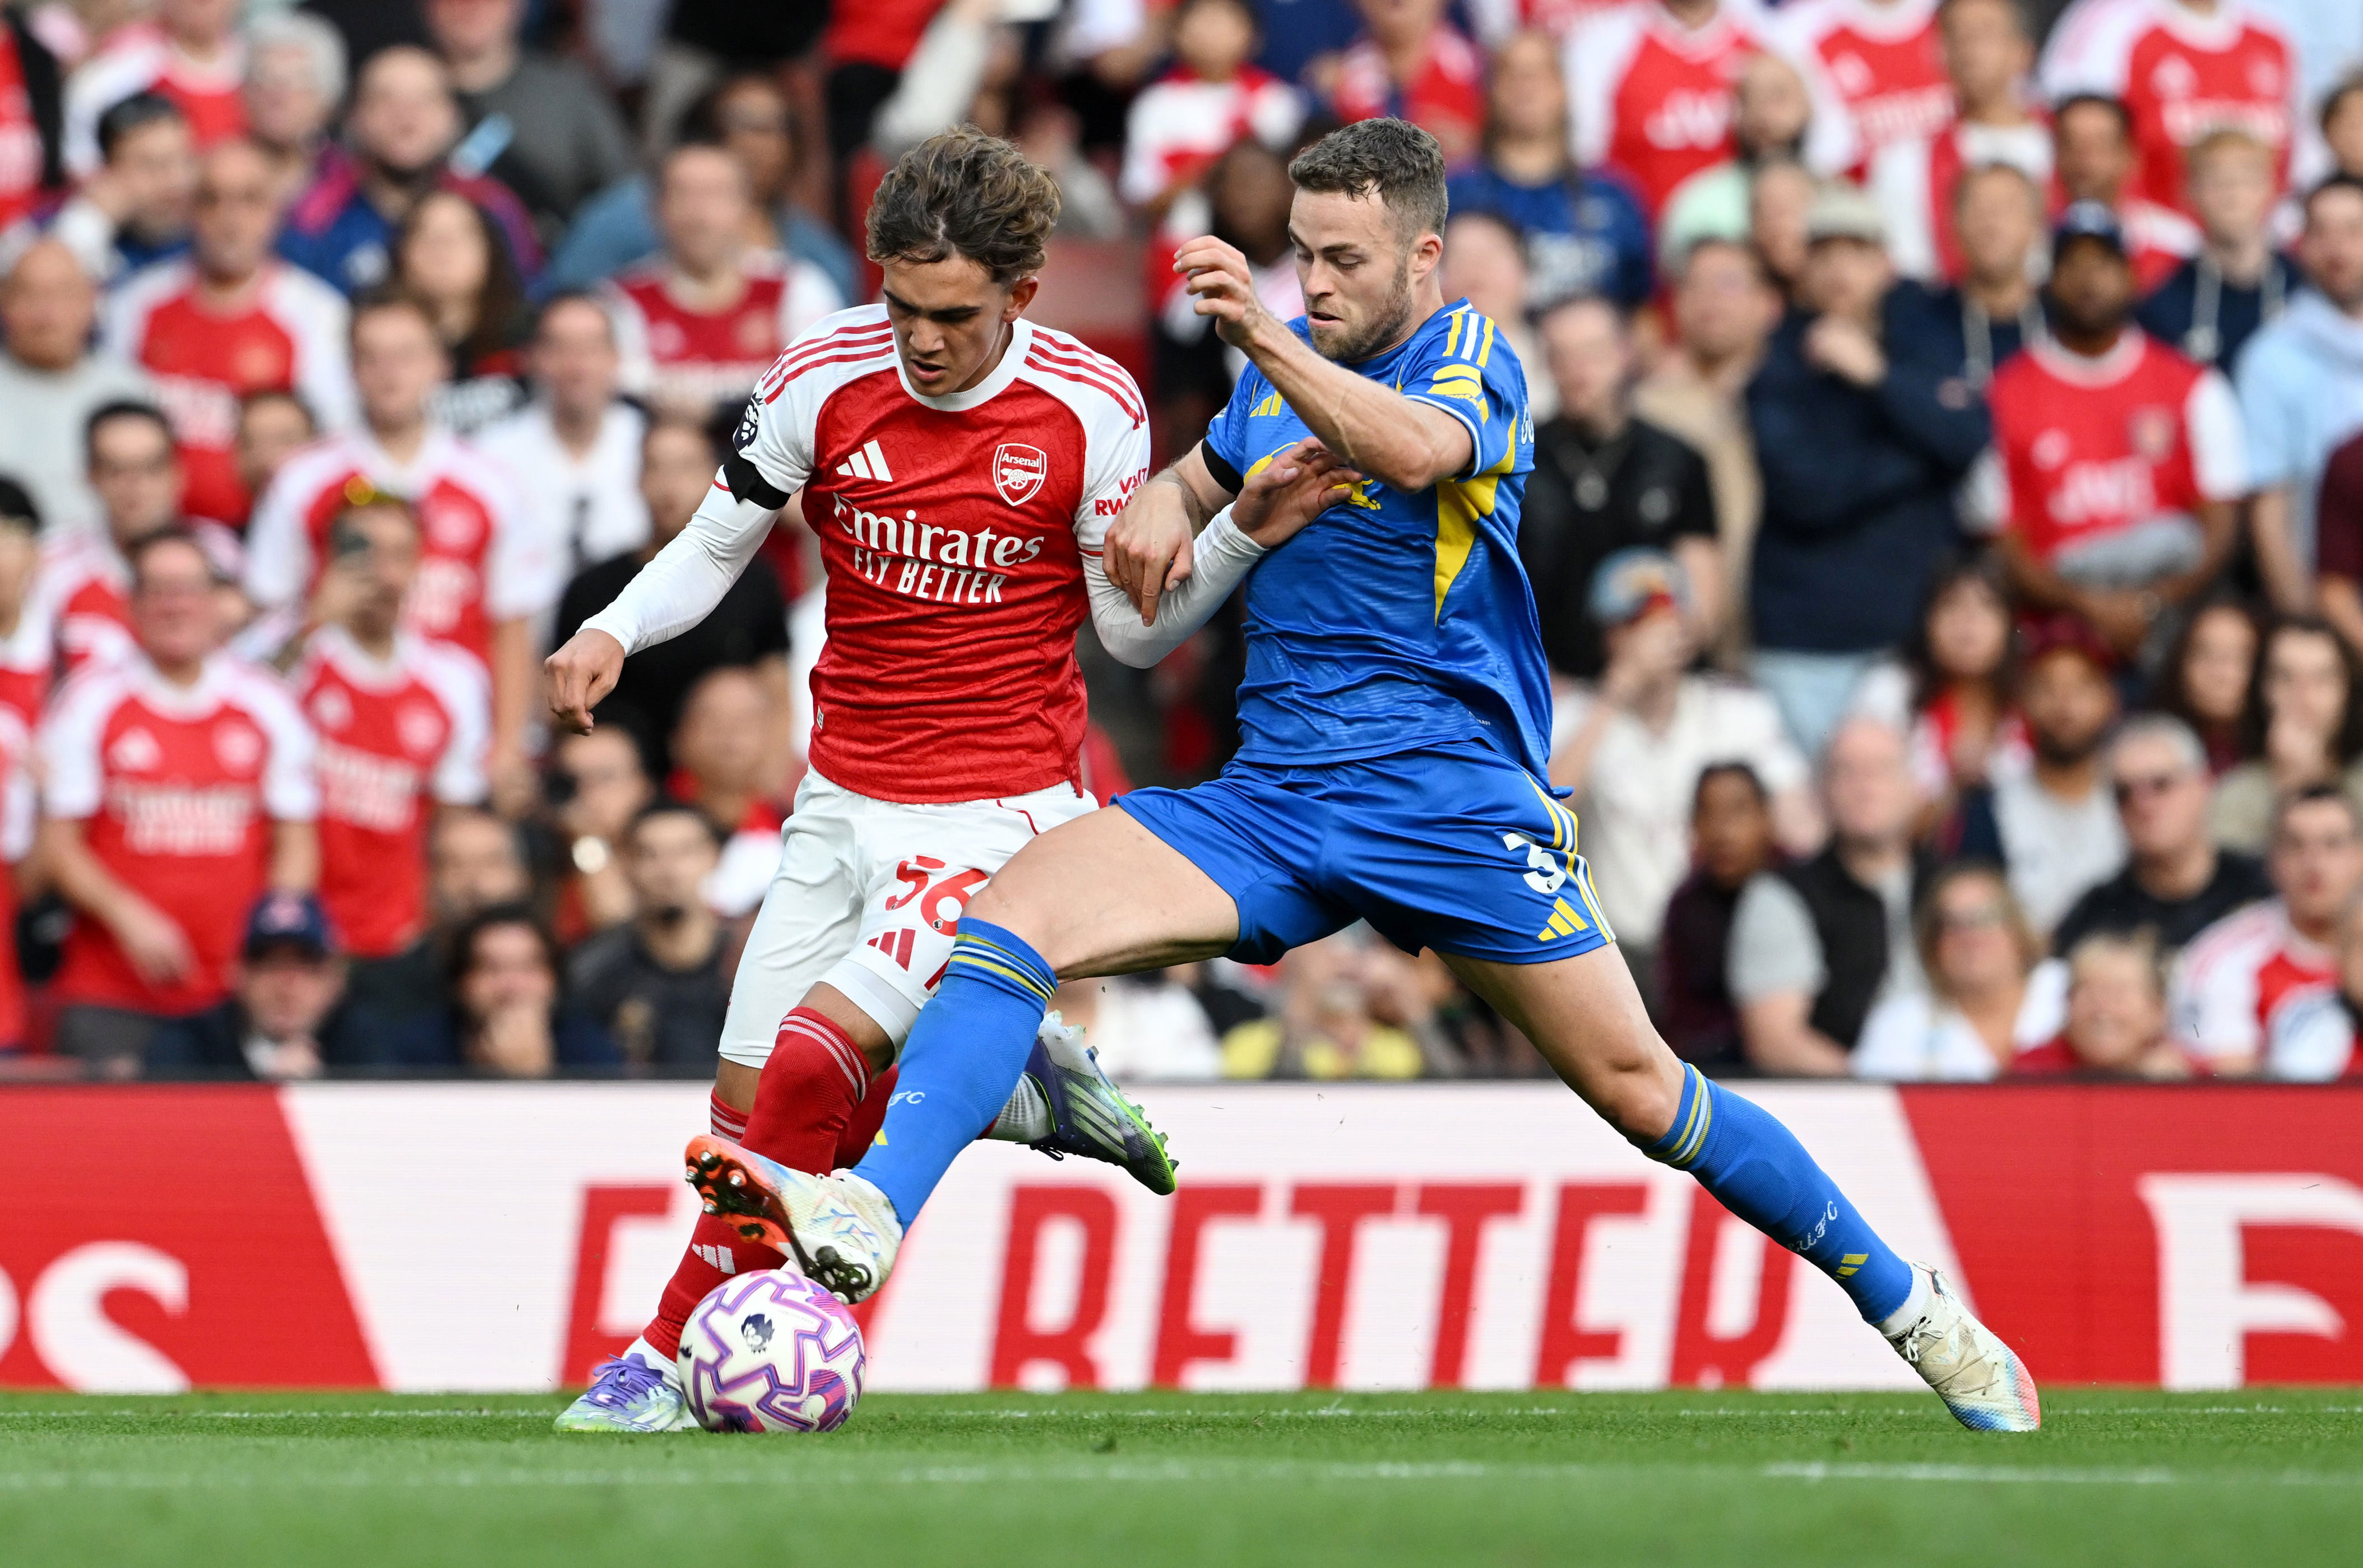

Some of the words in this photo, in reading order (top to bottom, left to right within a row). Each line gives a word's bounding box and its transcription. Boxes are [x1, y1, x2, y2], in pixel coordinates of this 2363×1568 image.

[1002, 452, 1040, 468] Arsenal
[833, 491, 1045, 568] Emirates
[854, 546, 892, 586] FLY
[896, 558, 1008, 604] BETTER
[1502, 832, 1567, 894] 3
[884, 855, 990, 937] 56
